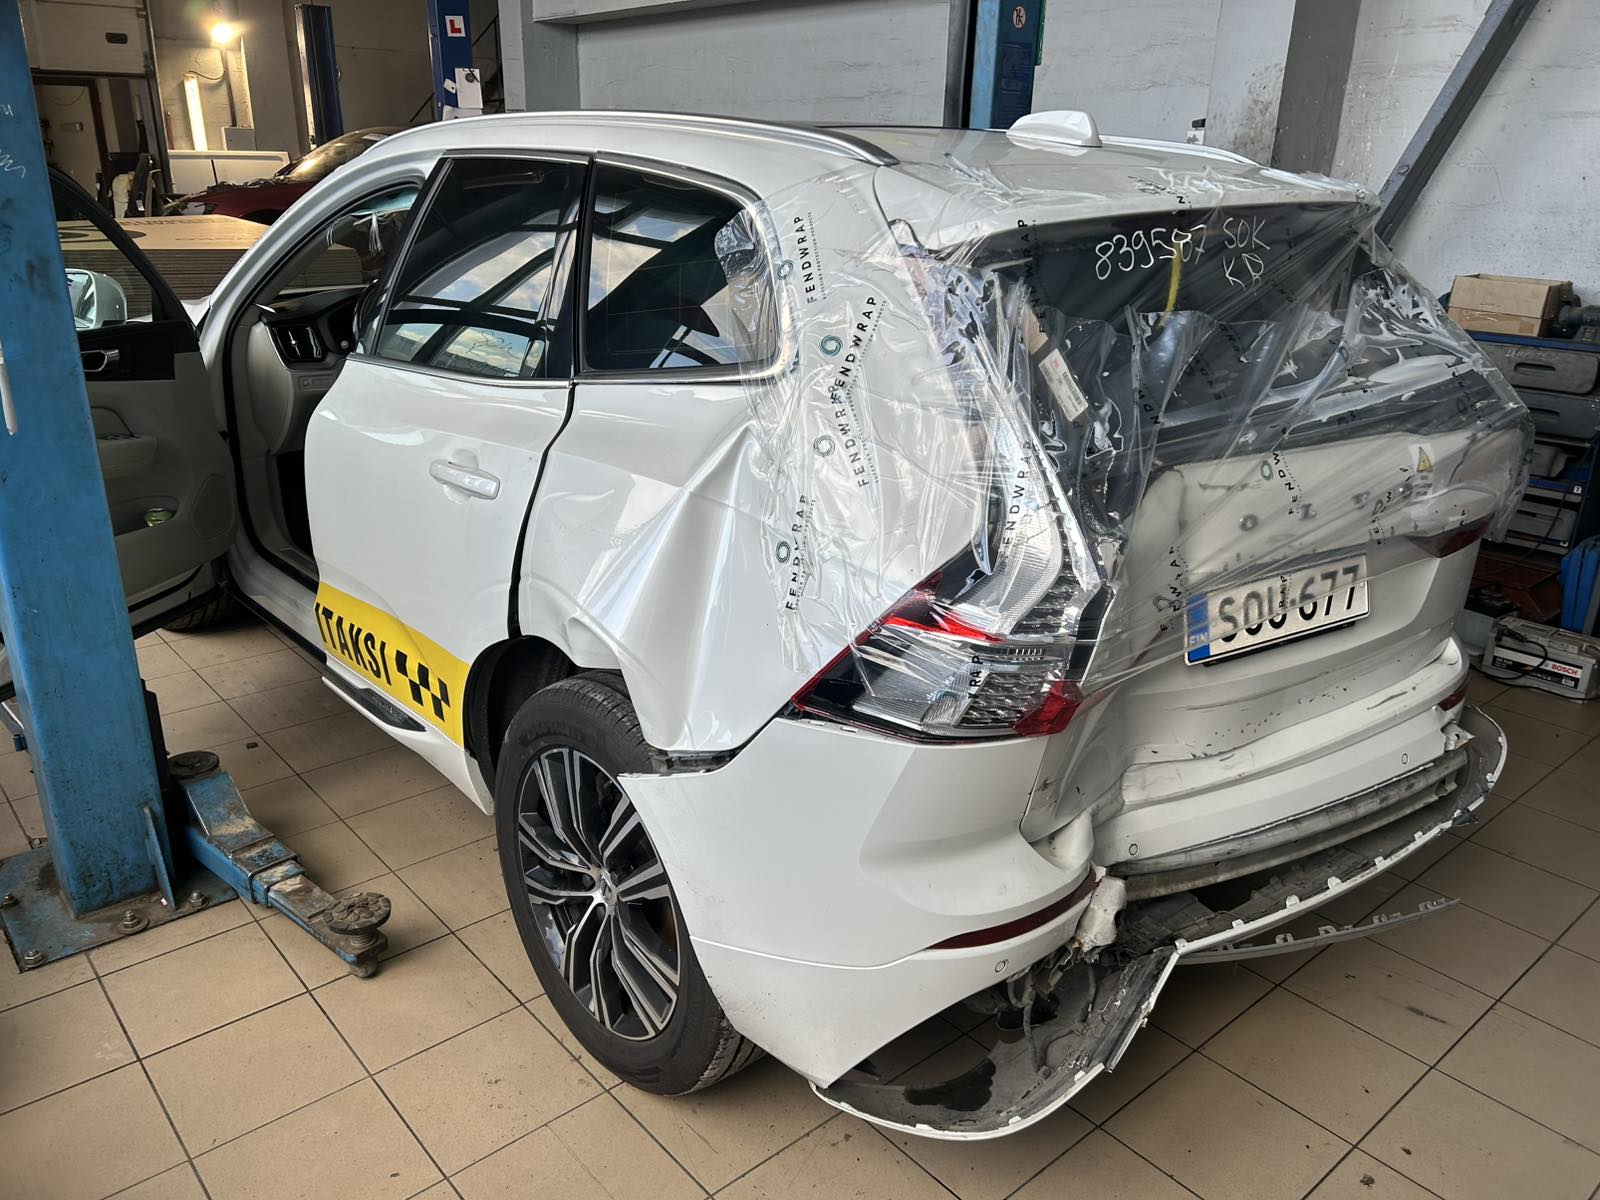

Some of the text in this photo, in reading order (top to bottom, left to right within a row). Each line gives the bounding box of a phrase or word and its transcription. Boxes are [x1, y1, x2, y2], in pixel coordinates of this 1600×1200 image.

[449, 19, 461, 34] L
[1223, 216, 1270, 250] SOK
[793, 216, 818, 304] FENDWRAP
[830, 297, 877, 405] FENDWRAP
[1551, 663, 1578, 676] BOSCH
